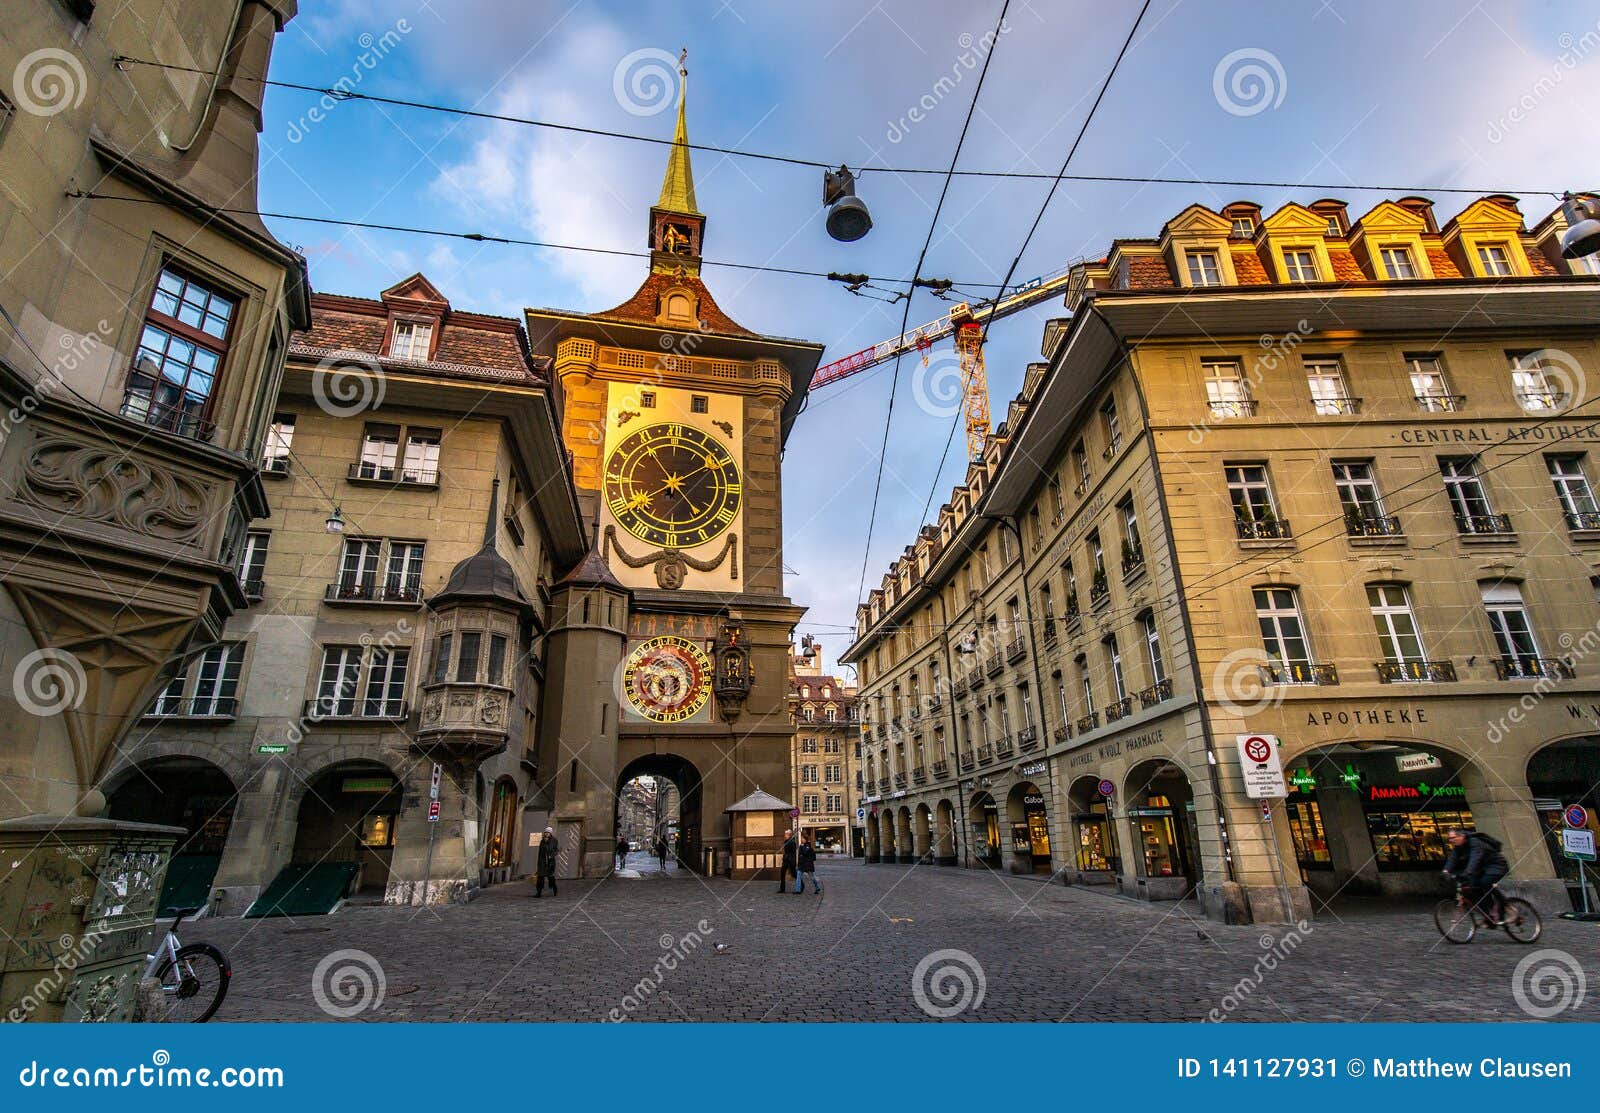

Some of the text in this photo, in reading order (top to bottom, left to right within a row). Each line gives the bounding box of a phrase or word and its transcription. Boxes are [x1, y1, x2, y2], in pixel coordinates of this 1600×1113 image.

[1401, 425, 1600, 443] CENTRAL APOTHEK
[1307, 708, 1429, 726] APOTHEKE
[1126, 729, 1164, 752] PHARMACIE
[1023, 796, 1044, 804] Gabor
